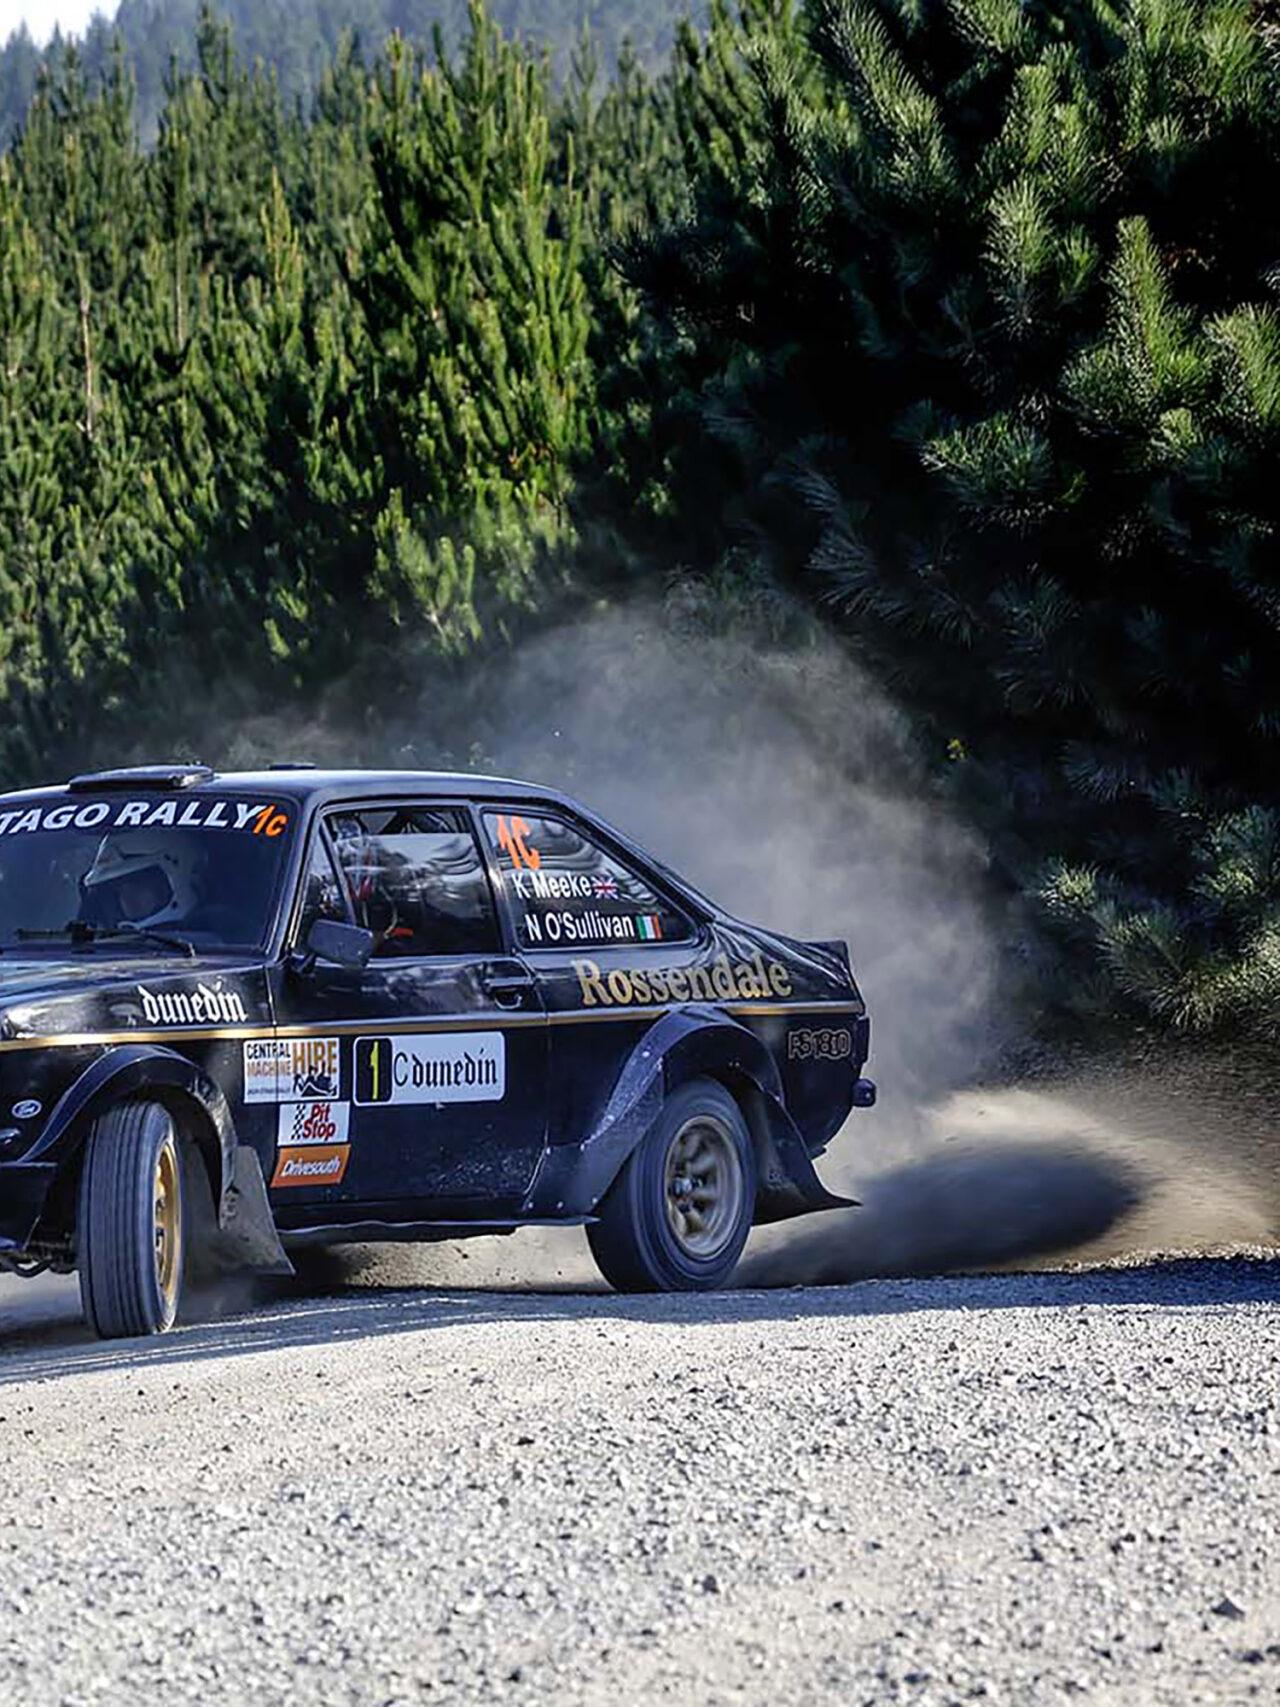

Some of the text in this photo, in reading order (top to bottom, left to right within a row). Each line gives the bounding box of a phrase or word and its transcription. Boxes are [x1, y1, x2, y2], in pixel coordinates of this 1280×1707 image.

[114, 800, 264, 829] RALLY
[511, 871, 592, 899] K Meeke
[525, 911, 634, 941] N O'Sullivan
[570, 950, 792, 1006] Rossendale
[137, 978, 248, 1024] dunedin
[246, 1042, 291, 1060] CENTRAL
[293, 1040, 338, 1075] HIRE
[247, 1060, 291, 1078] MACHINE
[370, 1040, 379, 1100] 1
[412, 1048, 497, 1087] dunedin
[311, 1104, 331, 1122] Pit
[302, 1121, 336, 1141] Stop
[281, 1157, 340, 1177] Drivesouth
